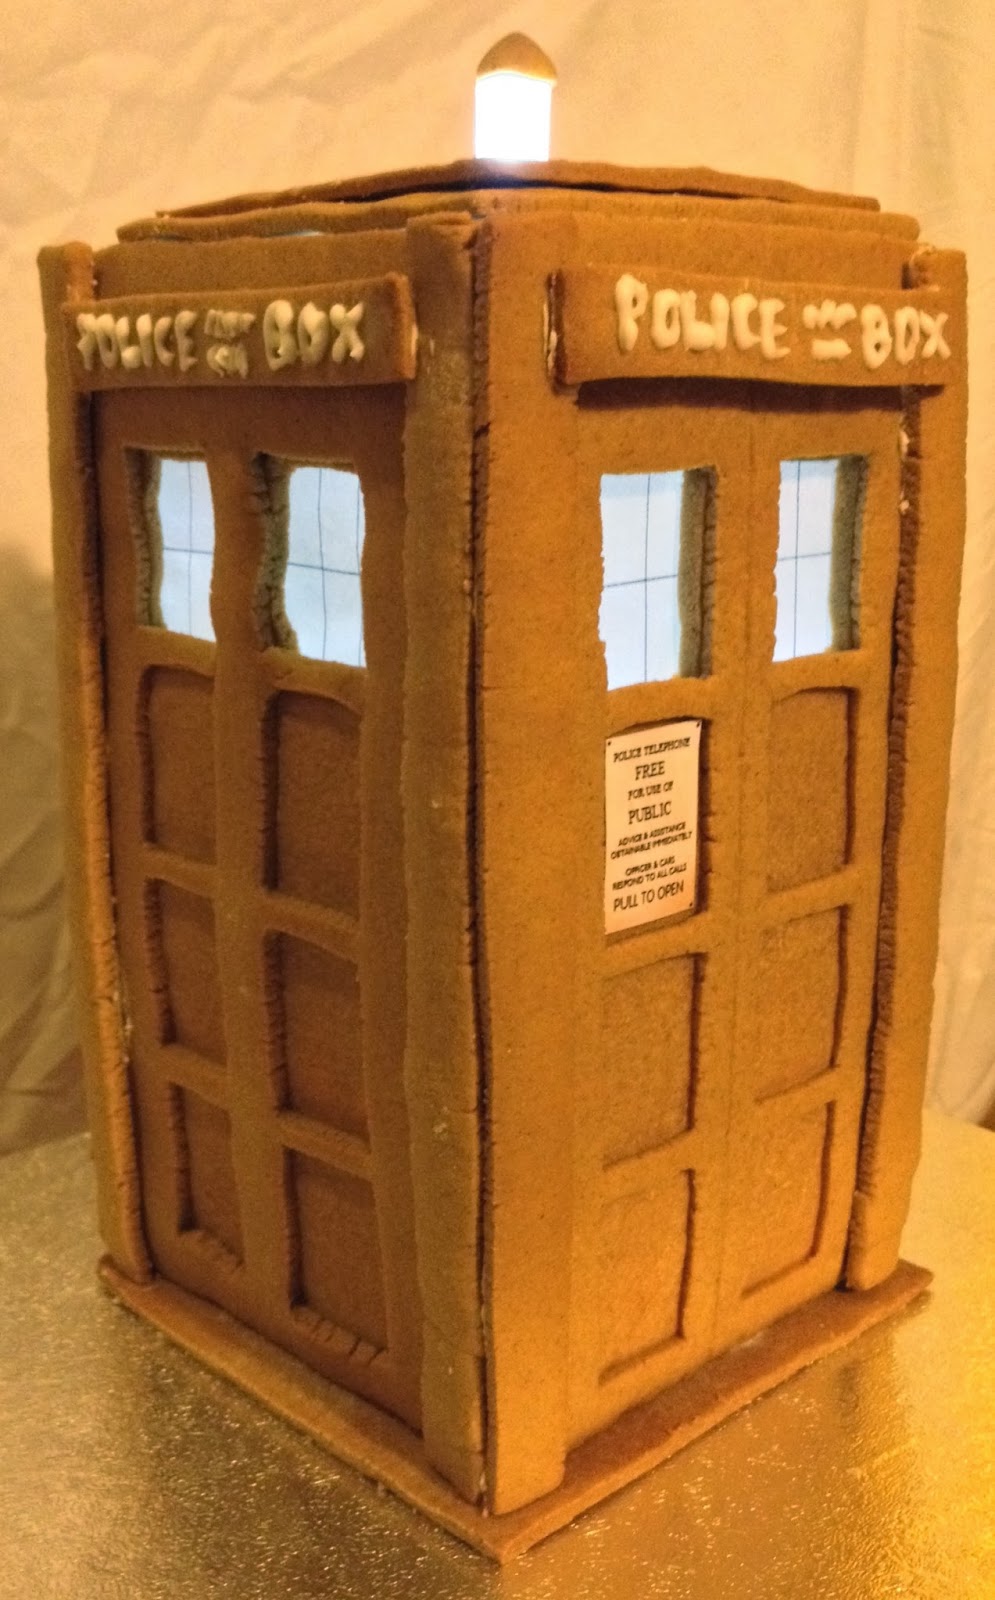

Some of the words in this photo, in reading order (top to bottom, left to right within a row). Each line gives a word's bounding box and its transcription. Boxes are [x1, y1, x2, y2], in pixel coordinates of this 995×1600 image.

[615, 273, 791, 360] POLICE
[860, 303, 951, 369] BOX
[262, 299, 364, 372] BOX
[613, 747, 642, 763] POLICE
[643, 737, 691, 755] TELEPHONE
[635, 760, 665, 780] FREE
[628, 787, 645, 800] FOR
[646, 783, 661, 796] USE
[663, 780, 674, 792] OF
[628, 800, 672, 825] PUBLIC
[618, 832, 642, 847] ADVICE
[649, 821, 686, 838] ASSISTANCE
[610, 841, 651, 860] OBTAINABLE
[660, 855, 676, 867] CARS
[612, 875, 644, 890] RESPOND
[645, 872, 656, 882] TO
[657, 869, 668, 879] ALL
[668, 862, 687, 876] CALLS
[613, 893, 638, 912] PULL
[641, 888, 655, 905] TO
[657, 879, 684, 900] OPEN
